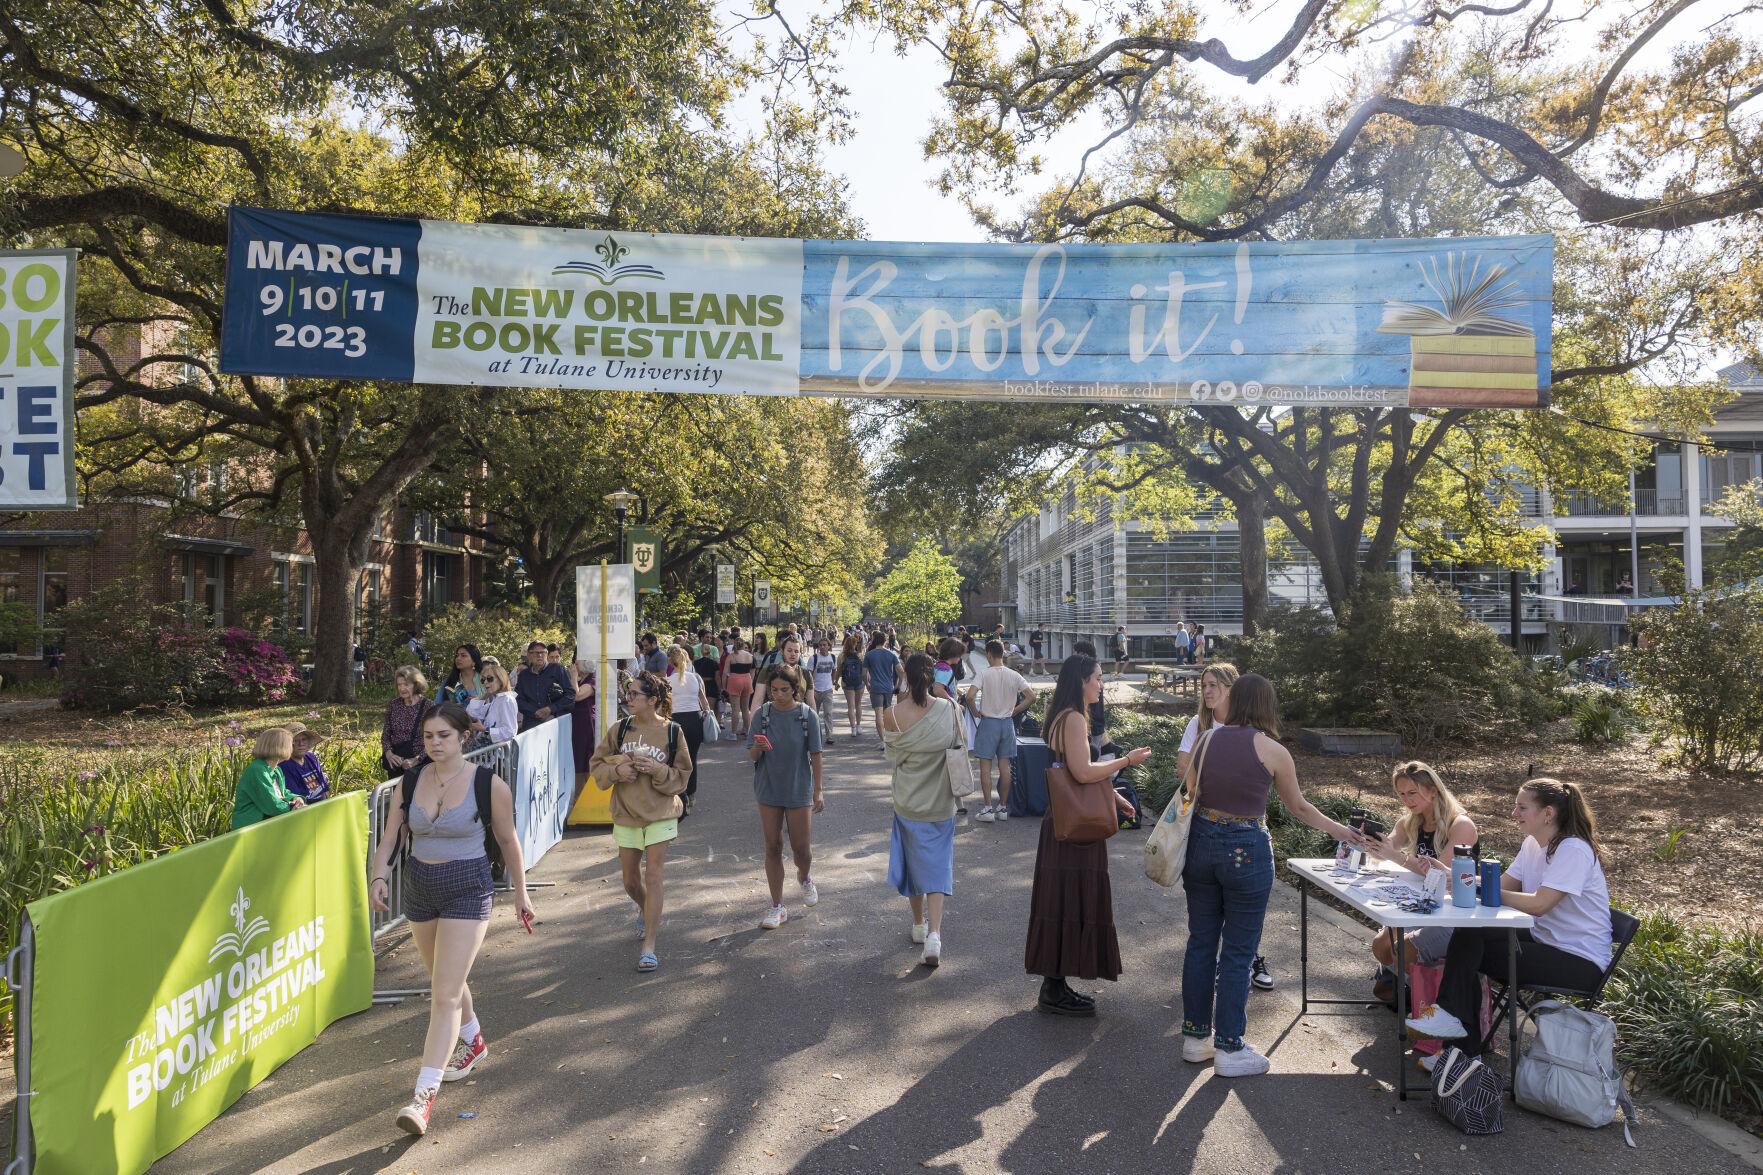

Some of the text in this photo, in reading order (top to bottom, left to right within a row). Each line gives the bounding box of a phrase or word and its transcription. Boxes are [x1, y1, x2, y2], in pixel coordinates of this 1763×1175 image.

[247, 240, 401, 275] MARCH
[0, 263, 61, 312] O
[431, 287, 784, 327] The NEW ORLEANS
[828, 242, 1252, 393] Book it!
[0, 318, 61, 367] K
[274, 323, 367, 358] 2023
[431, 320, 783, 361] BOOK FESTIVAL
[488, 356, 723, 388] at Tulane University
[1003, 380, 1163, 398] bookfest.tulane.edu
[1266, 384, 1388, 401] @nolabookfest
[0, 385, 58, 435] E
[0, 442, 60, 490] T
[620, 741, 666, 762] MILNO
[125, 915, 325, 1065] The NEW ORLEANS
[127, 952, 326, 1112] BOOK FESTIVAL
[171, 1002, 301, 1108] at Tulane University
